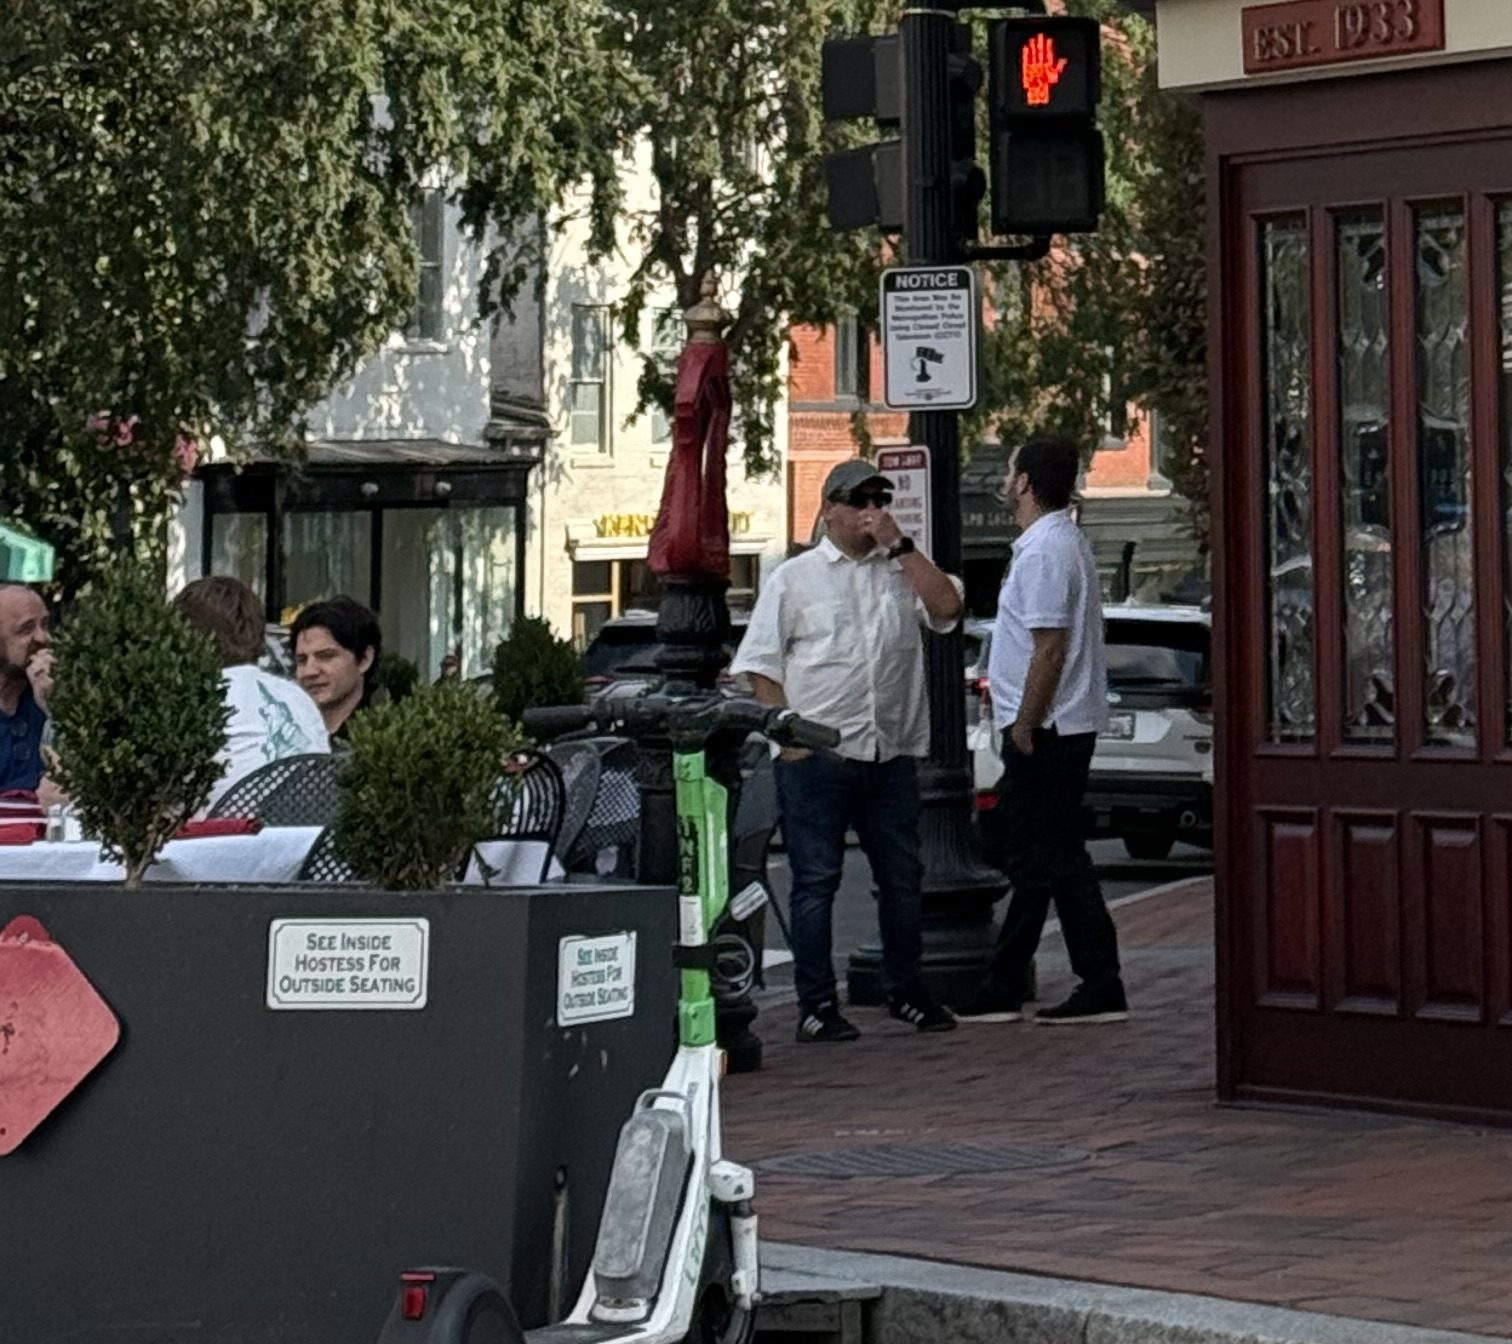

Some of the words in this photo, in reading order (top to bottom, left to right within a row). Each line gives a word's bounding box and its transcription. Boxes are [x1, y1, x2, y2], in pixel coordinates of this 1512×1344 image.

[895, 272, 959, 289] NOTICE
[306, 933, 337, 951] SEE
[341, 933, 391, 951] INSIDE
[295, 954, 366, 972] HOSTESS
[369, 954, 401, 972] FOR
[279, 975, 346, 993] OUTSIDE
[350, 975, 415, 993] SEATING
